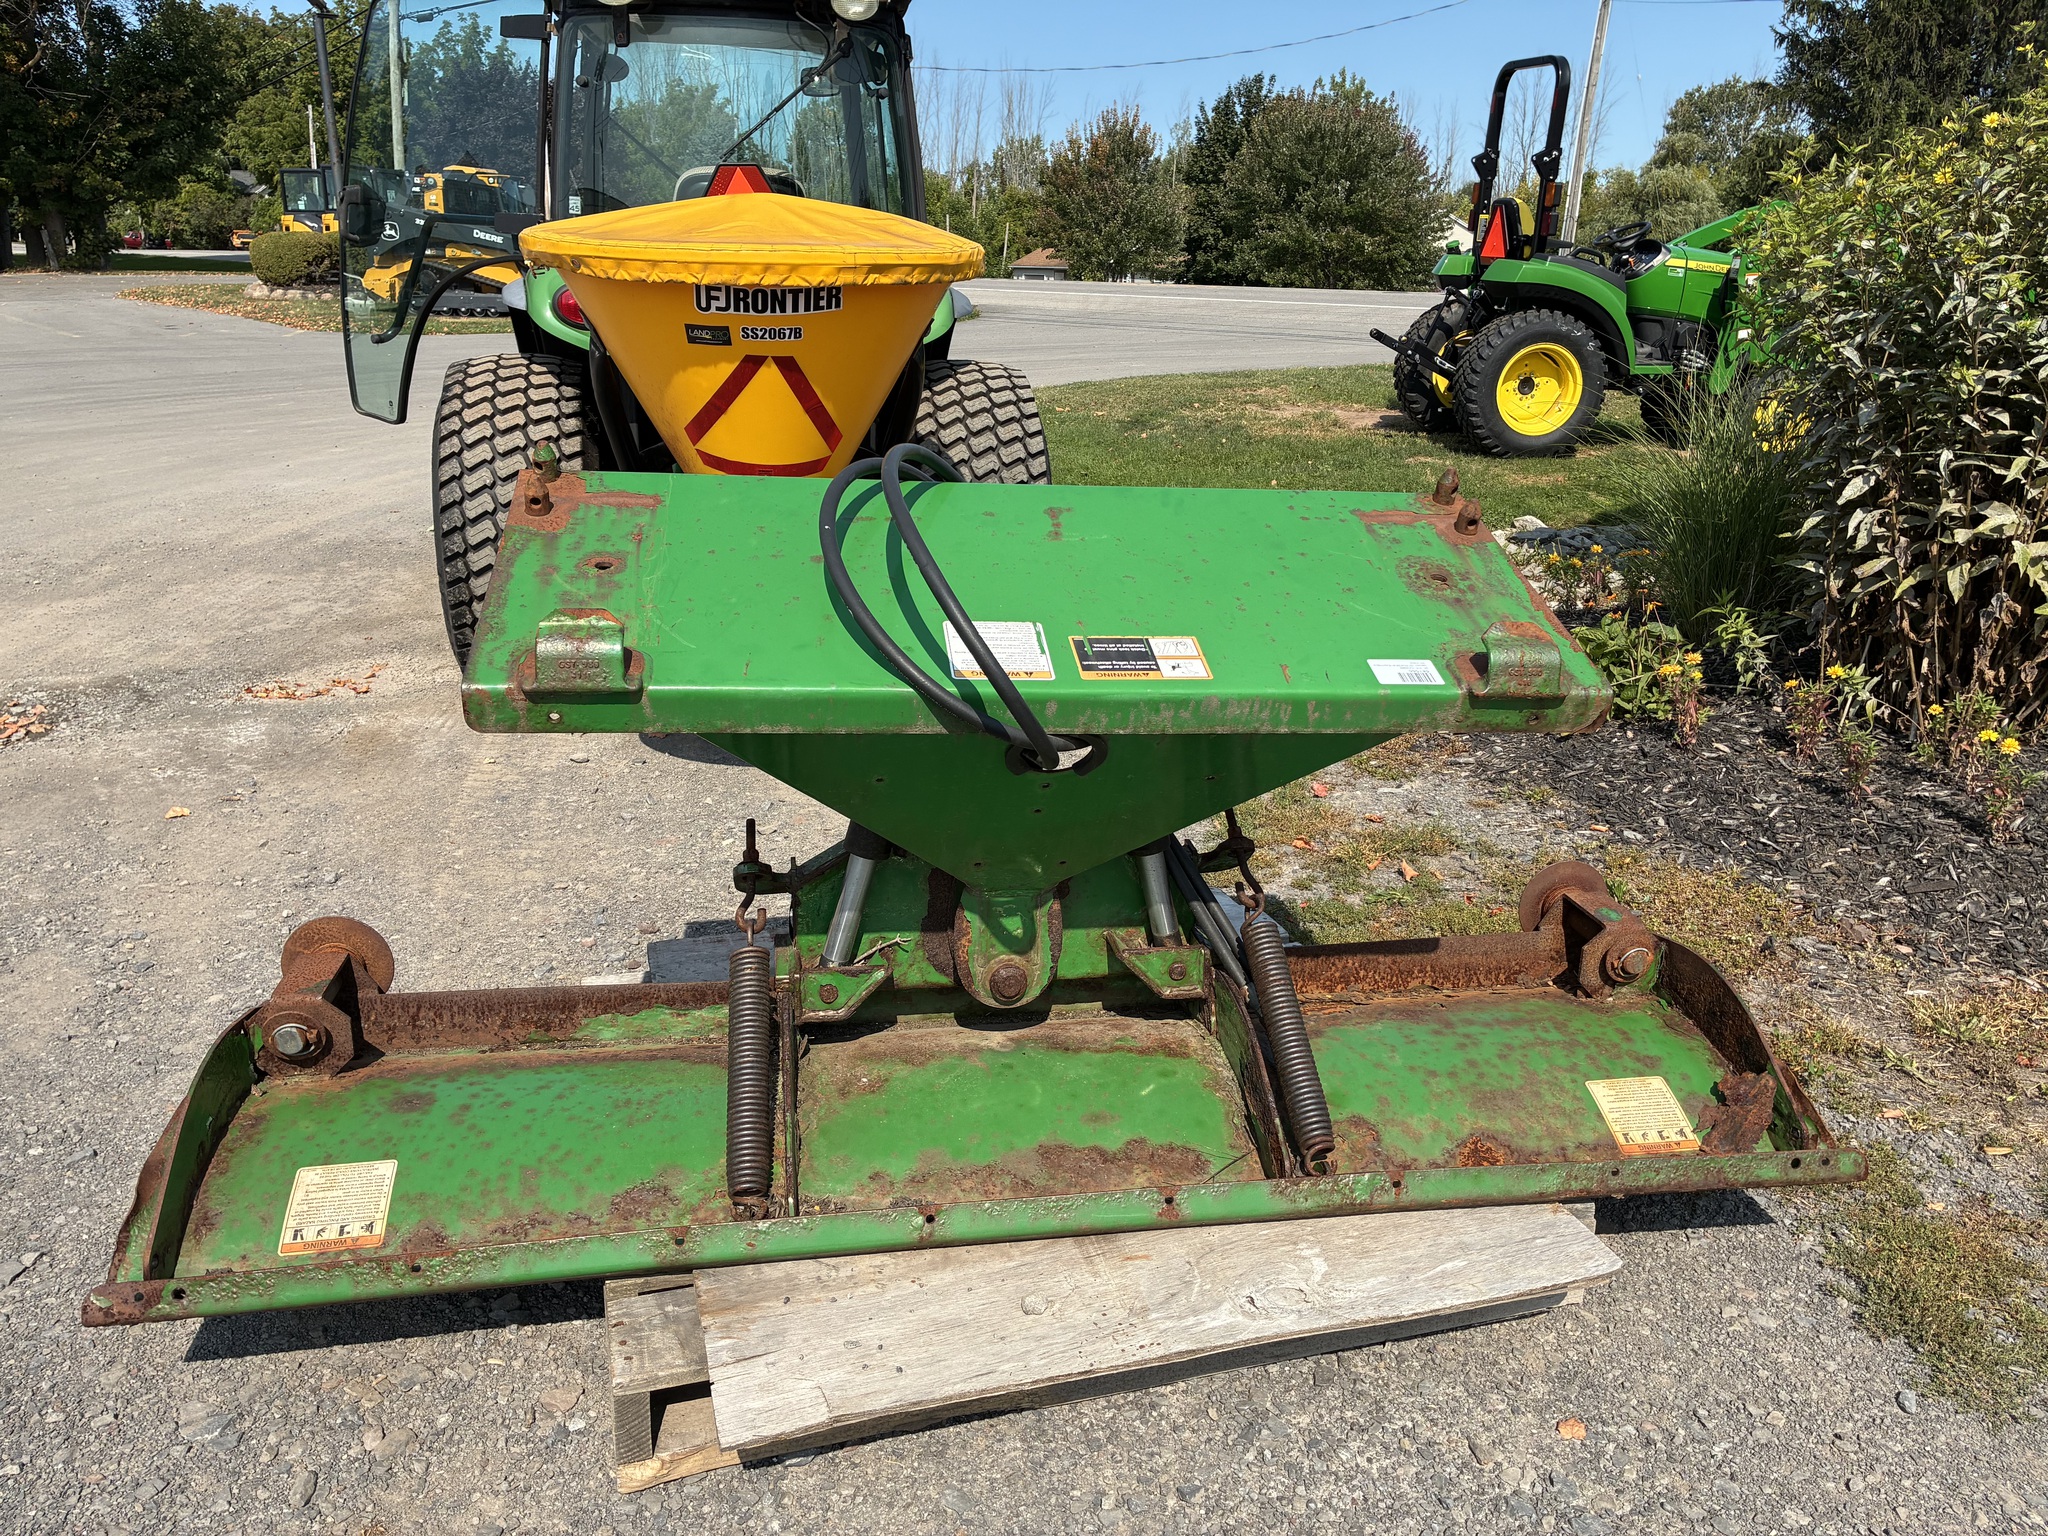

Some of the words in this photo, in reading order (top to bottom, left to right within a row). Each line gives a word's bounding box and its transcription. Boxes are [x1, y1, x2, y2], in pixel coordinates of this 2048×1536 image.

[473, 229, 504, 244] DEERE
[1694, 262, 1715, 270] JOHN
[688, 328, 729, 339] LANDPRO
[741, 326, 803, 340] SS2067B
[1637, 1142, 1674, 1151] WARNING
[303, 1239, 348, 1250] WARNING
